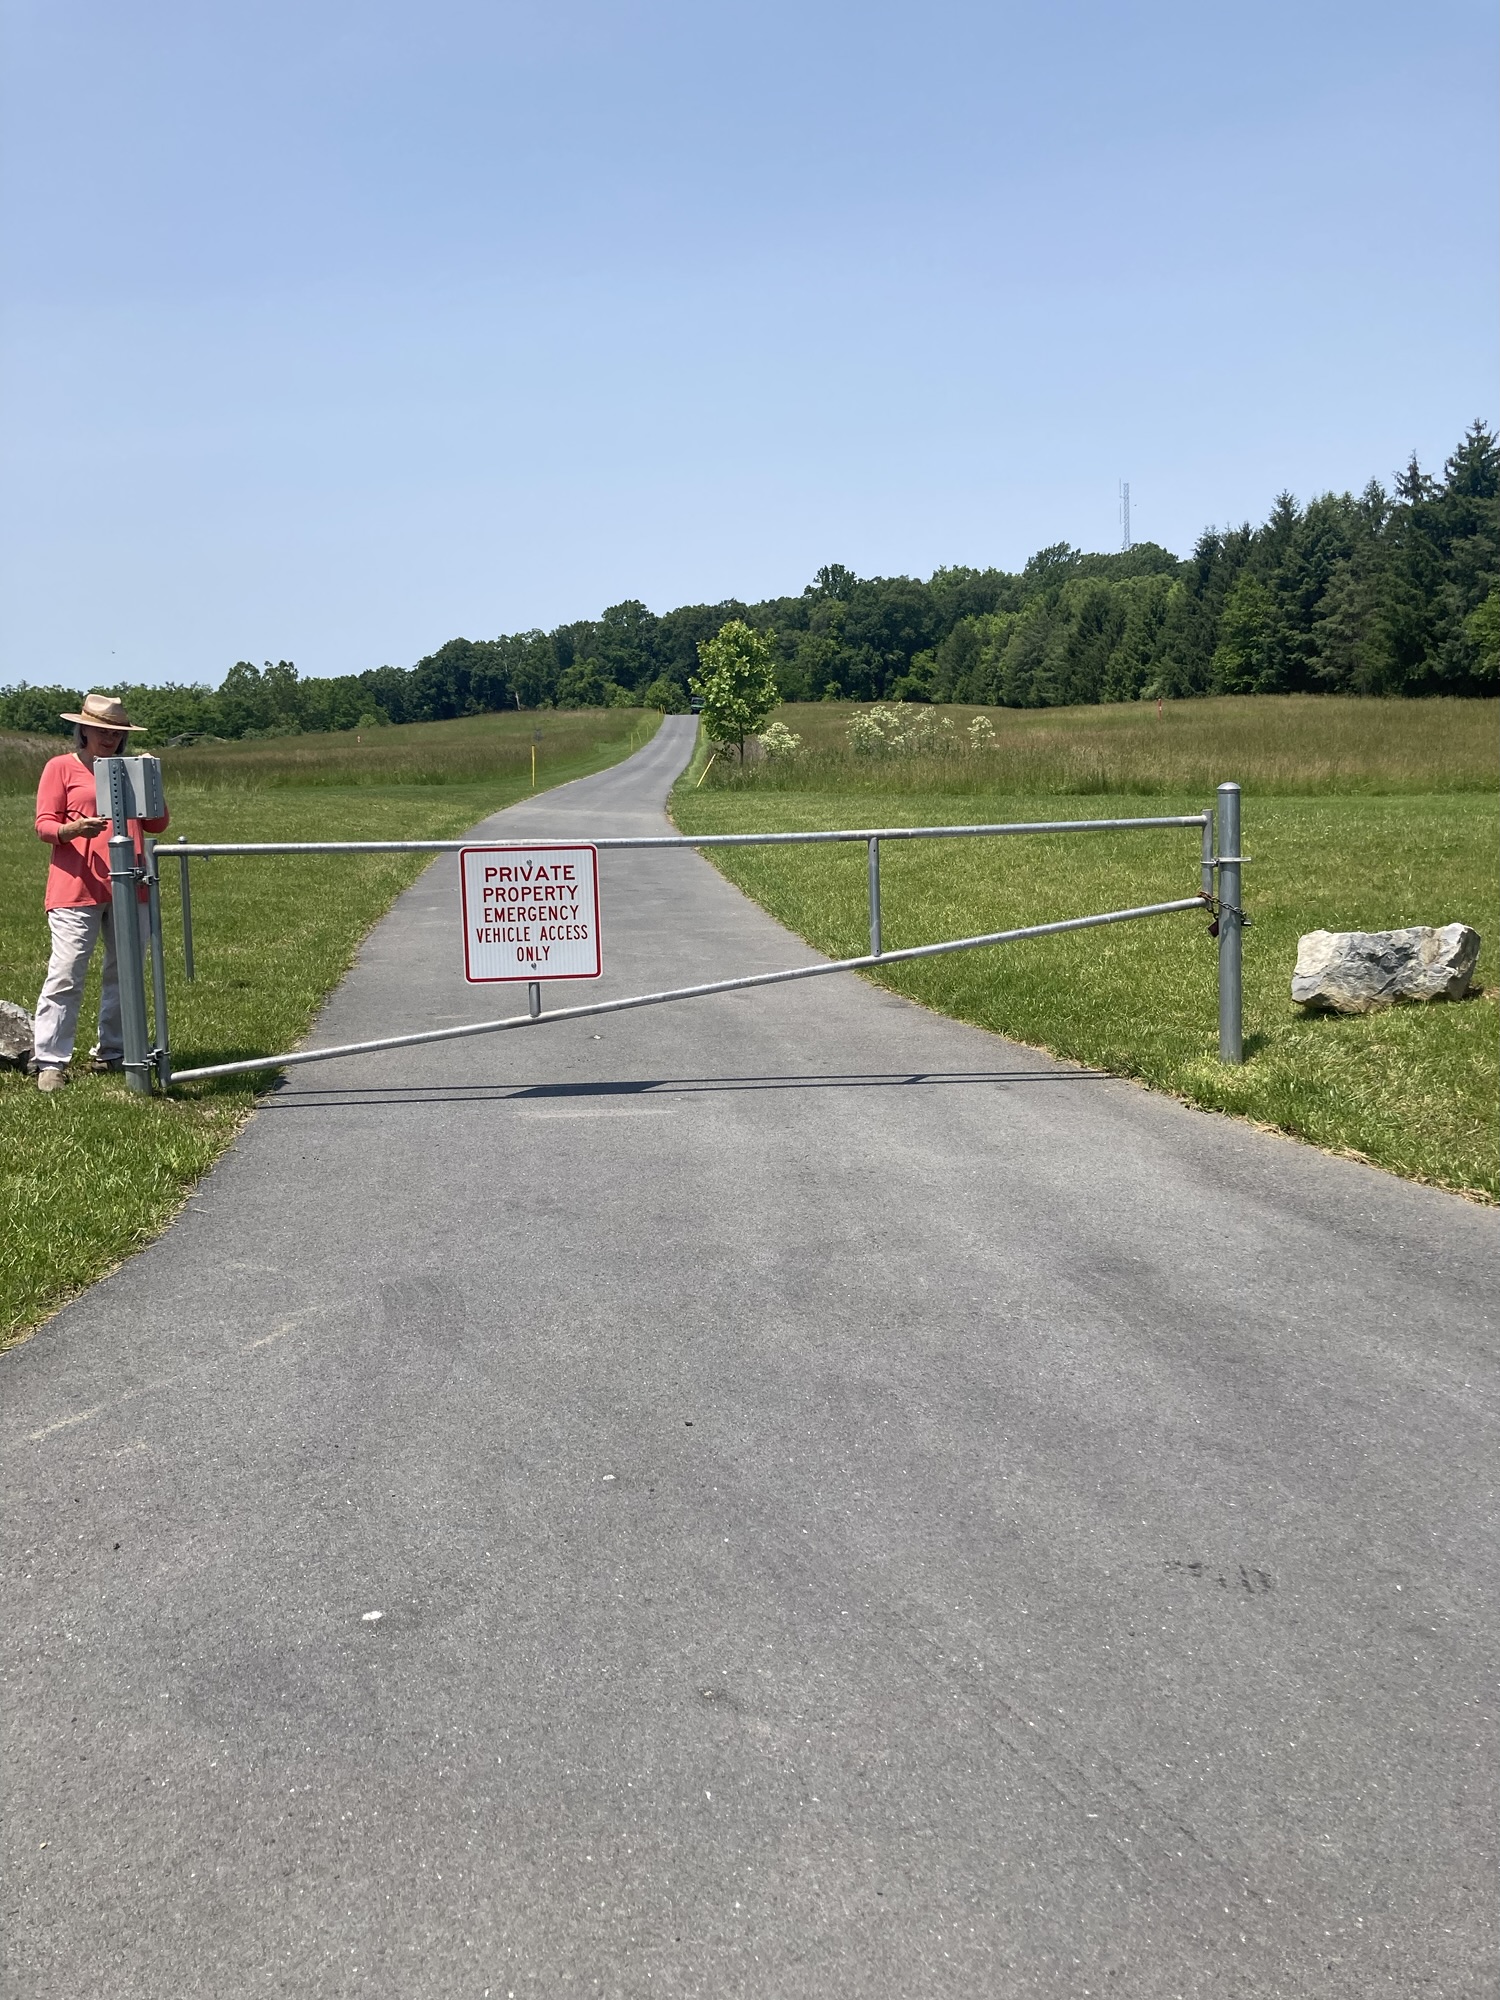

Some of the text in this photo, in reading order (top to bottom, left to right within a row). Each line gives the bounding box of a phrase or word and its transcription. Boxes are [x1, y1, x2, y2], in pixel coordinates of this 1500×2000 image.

[485, 865, 576, 883] PRIVATE
[483, 885, 578, 903] PROPERTY
[484, 905, 579, 923] EMERGENCY
[476, 924, 588, 943] VEHICLE ACCESS
[516, 946, 550, 962] ONLY
